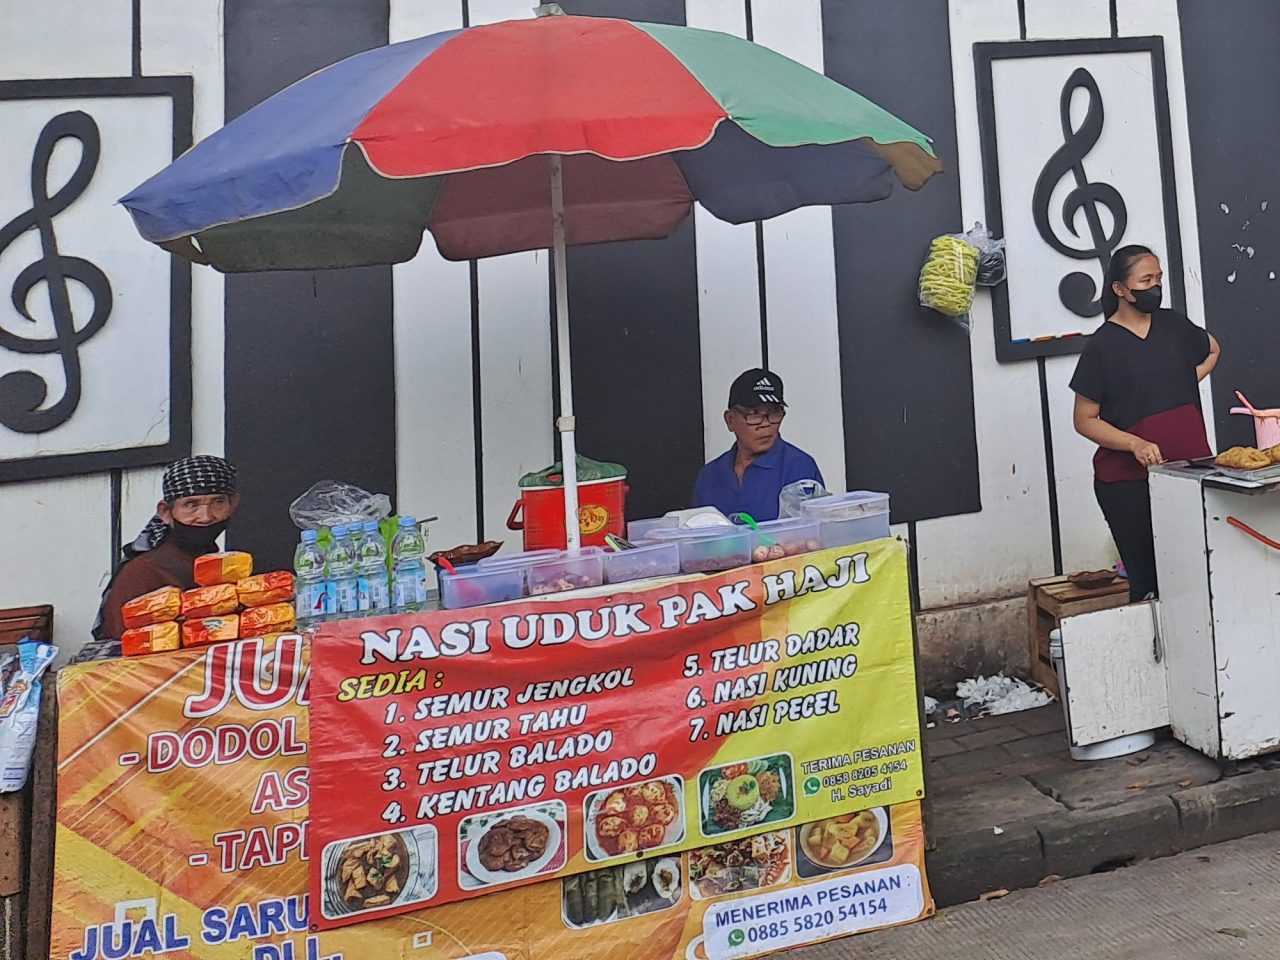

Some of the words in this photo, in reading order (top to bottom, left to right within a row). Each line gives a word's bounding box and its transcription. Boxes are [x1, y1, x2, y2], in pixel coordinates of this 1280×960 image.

[360, 619, 491, 665] NASI
[501, 602, 651, 650] UDUK
[659, 581, 757, 629] PAK
[762, 552, 870, 606] HAJI
[183, 634, 311, 718] JU
[683, 654, 704, 678] 5.
[711, 639, 780, 672] TELUR
[785, 622, 860, 657] DADAR
[338, 669, 427, 702] SEDIA
[384, 702, 406, 725] 1.
[414, 687, 509, 721] SEMUR
[516, 667, 635, 704] JENGKOL
[685, 687, 707, 709] 6.
[713, 672, 768, 704] NASI
[773, 654, 857, 692] KUNING
[381, 735, 407, 758] 2.
[414, 718, 510, 753] SEMUR
[518, 704, 588, 735] TAHU
[689, 718, 709, 742] 7.
[715, 704, 769, 736] NASI
[774, 691, 840, 724] PECEL
[147, 716, 307, 773] DODOL
[382, 768, 407, 791] 3.
[417, 751, 500, 786] TELUR
[509, 730, 613, 769] BALADO
[801, 755, 851, 774] TERIMA
[854, 739, 916, 763] PESANAN
[381, 801, 407, 824] 4.
[417, 775, 546, 819] KENTANG
[554, 753, 657, 793] BALADO
[823, 772, 849, 788] 0858
[851, 766, 878, 780] 8205
[880, 759, 908, 774] 4154
[831, 789, 845, 802] H.
[848, 777, 892, 798] Sayadi
[69, 913, 189, 960] JUAL
[201, 894, 310, 945] SARU
[715, 894, 813, 927] MENERIMA
[817, 874, 902, 905] PESANAN
[748, 920, 789, 943] 0885
[793, 910, 834, 933] 5820
[838, 898, 888, 921] 54154
